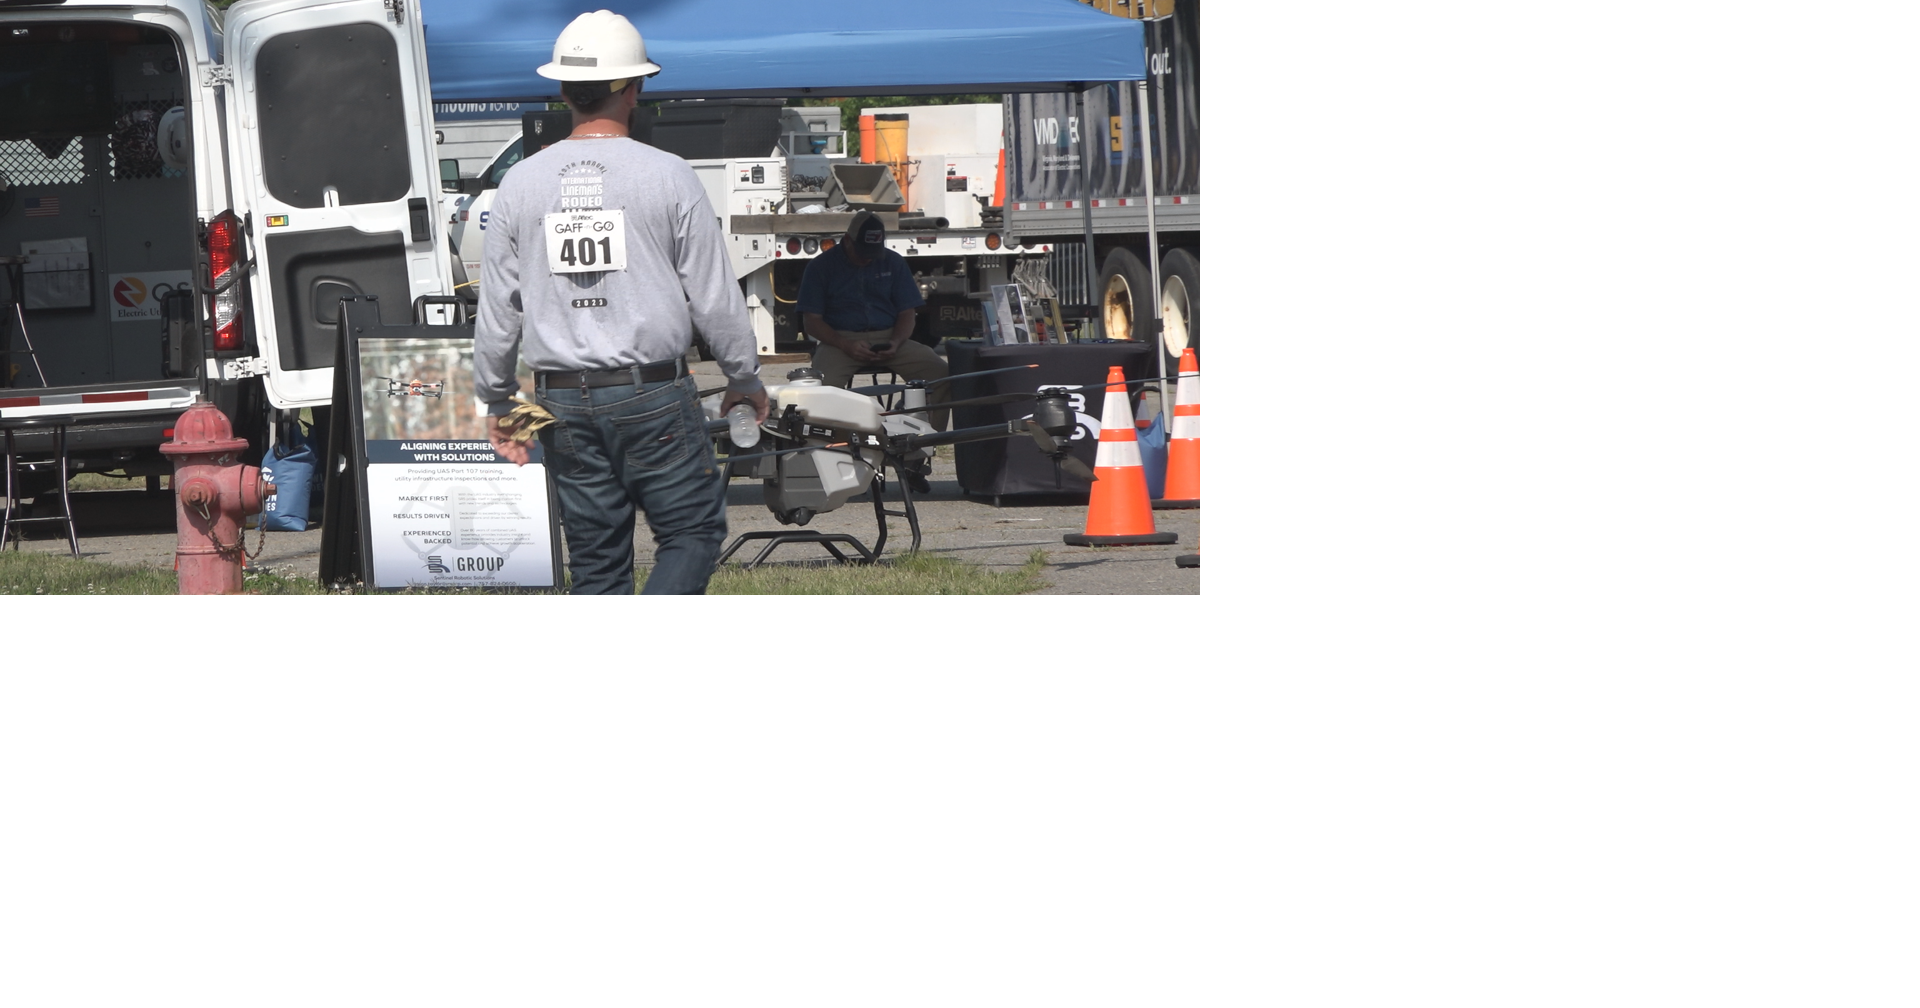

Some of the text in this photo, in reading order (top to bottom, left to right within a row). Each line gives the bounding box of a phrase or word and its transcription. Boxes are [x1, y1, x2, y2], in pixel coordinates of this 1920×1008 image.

[1151, 47, 1172, 75] out.
[561, 177, 603, 185] INTERNATIONAL
[561, 184, 603, 196] LINEMAN'S
[561, 196, 603, 208] RODEO
[555, 222, 583, 234] GAFF
[560, 236, 612, 266] 401
[575, 299, 603, 307] 2023
[117, 308, 148, 318] Electric
[413, 453, 496, 462] WITH SOLUTIONS
[457, 556, 504, 572] GROUP
